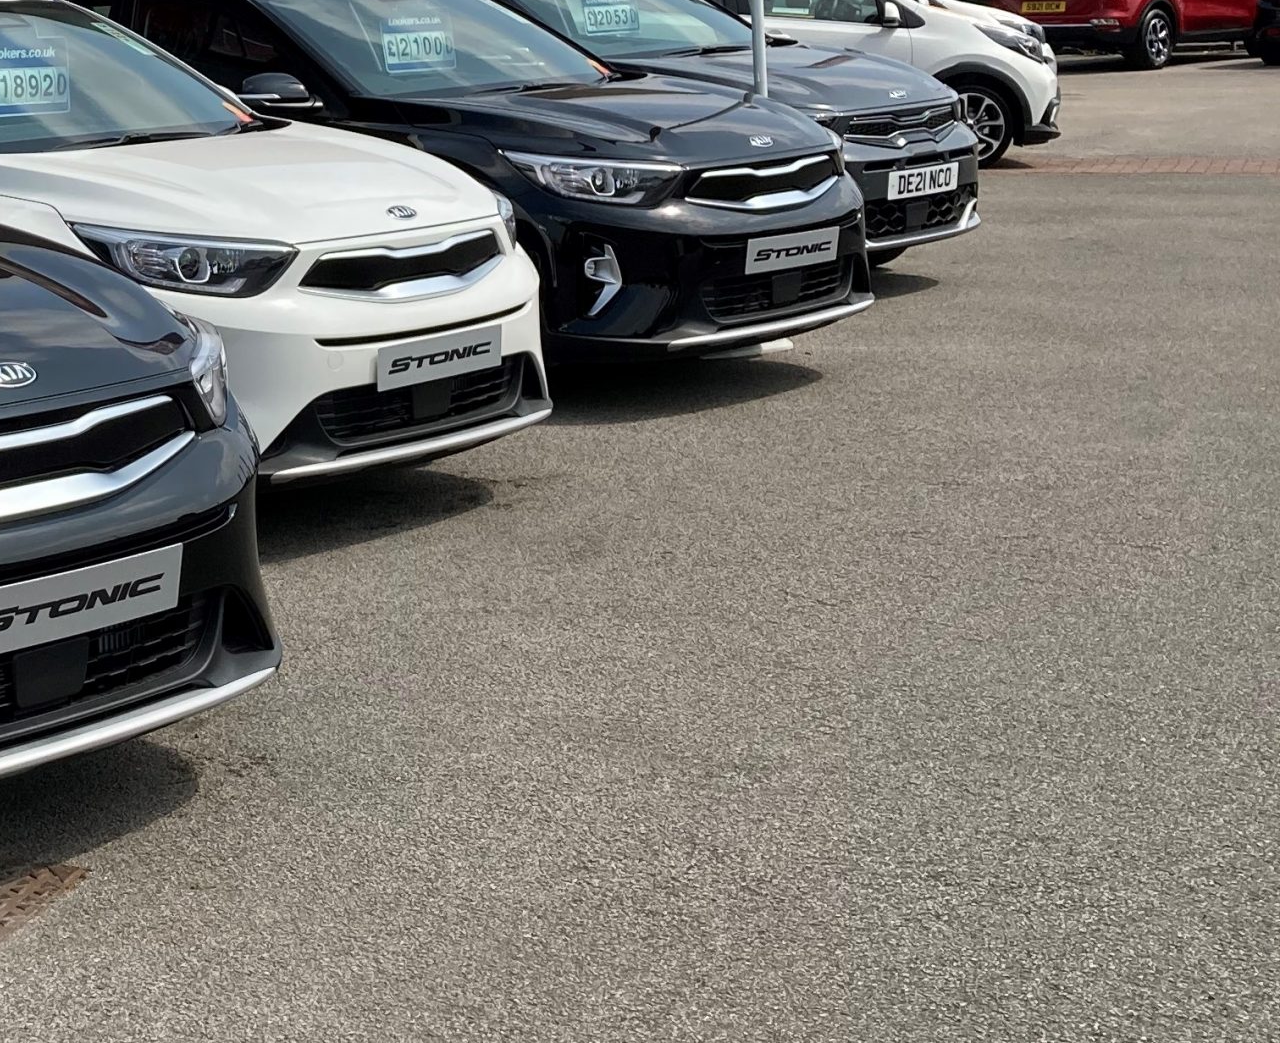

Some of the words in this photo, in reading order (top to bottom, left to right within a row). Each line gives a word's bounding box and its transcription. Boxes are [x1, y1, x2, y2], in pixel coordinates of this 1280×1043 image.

[587, 9, 637, 27] £20530
[897, 170, 927, 195] DE21
[928, 167, 952, 190] NCO
[753, 240, 832, 263] STONIC
[388, 340, 492, 376] STONIC
